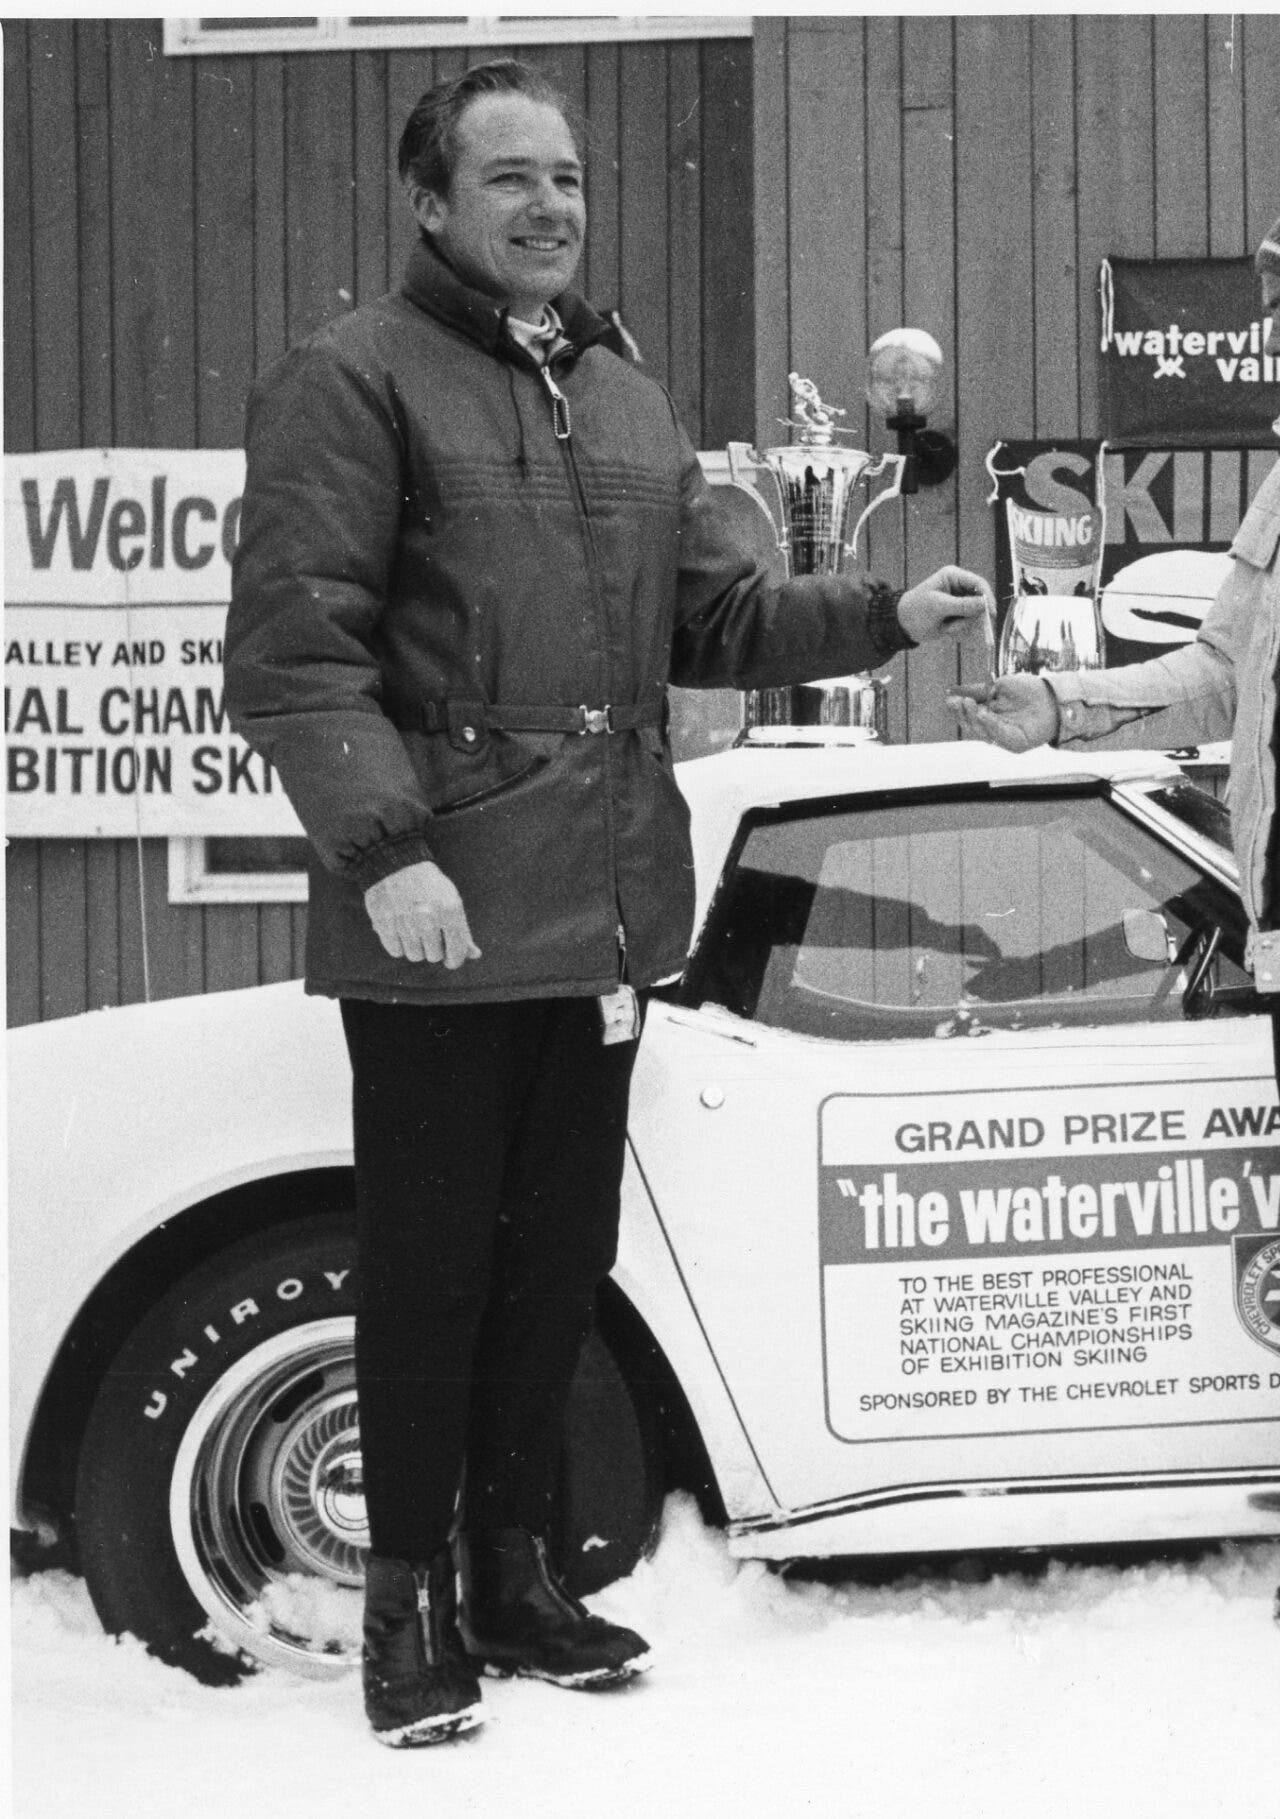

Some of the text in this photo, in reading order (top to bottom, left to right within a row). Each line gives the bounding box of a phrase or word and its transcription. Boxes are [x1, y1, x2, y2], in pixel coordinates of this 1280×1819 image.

[112, 642, 166, 666] AND
[7, 746, 172, 794] BITION
[895, 1117, 1045, 1153] GRAND
[1064, 1110, 1187, 1145] PRIZE
[899, 1263, 1193, 1294] TO THE BEST PROFESSIONAL
[900, 1283, 1192, 1315] AT WATERVILLE VALLEY AND
[1243, 1261, 1271, 1335] CHEVROLET
[900, 1304, 1193, 1336] SKIING MAGAZINE'S FIRST
[144, 1269, 350, 1419] UNIROY
[900, 1323, 1193, 1356] NATIONAL CHAMPIONSHIPS
[901, 1346, 1148, 1376] OF EXHIBITION SKIING
[859, 1389, 977, 1412] SPONSORED
[987, 1387, 1011, 1405] BY
[1019, 1385, 1058, 1403] THE
[1066, 1378, 1178, 1401] CHEVROLET
[1189, 1373, 1260, 1394] SPORTS
